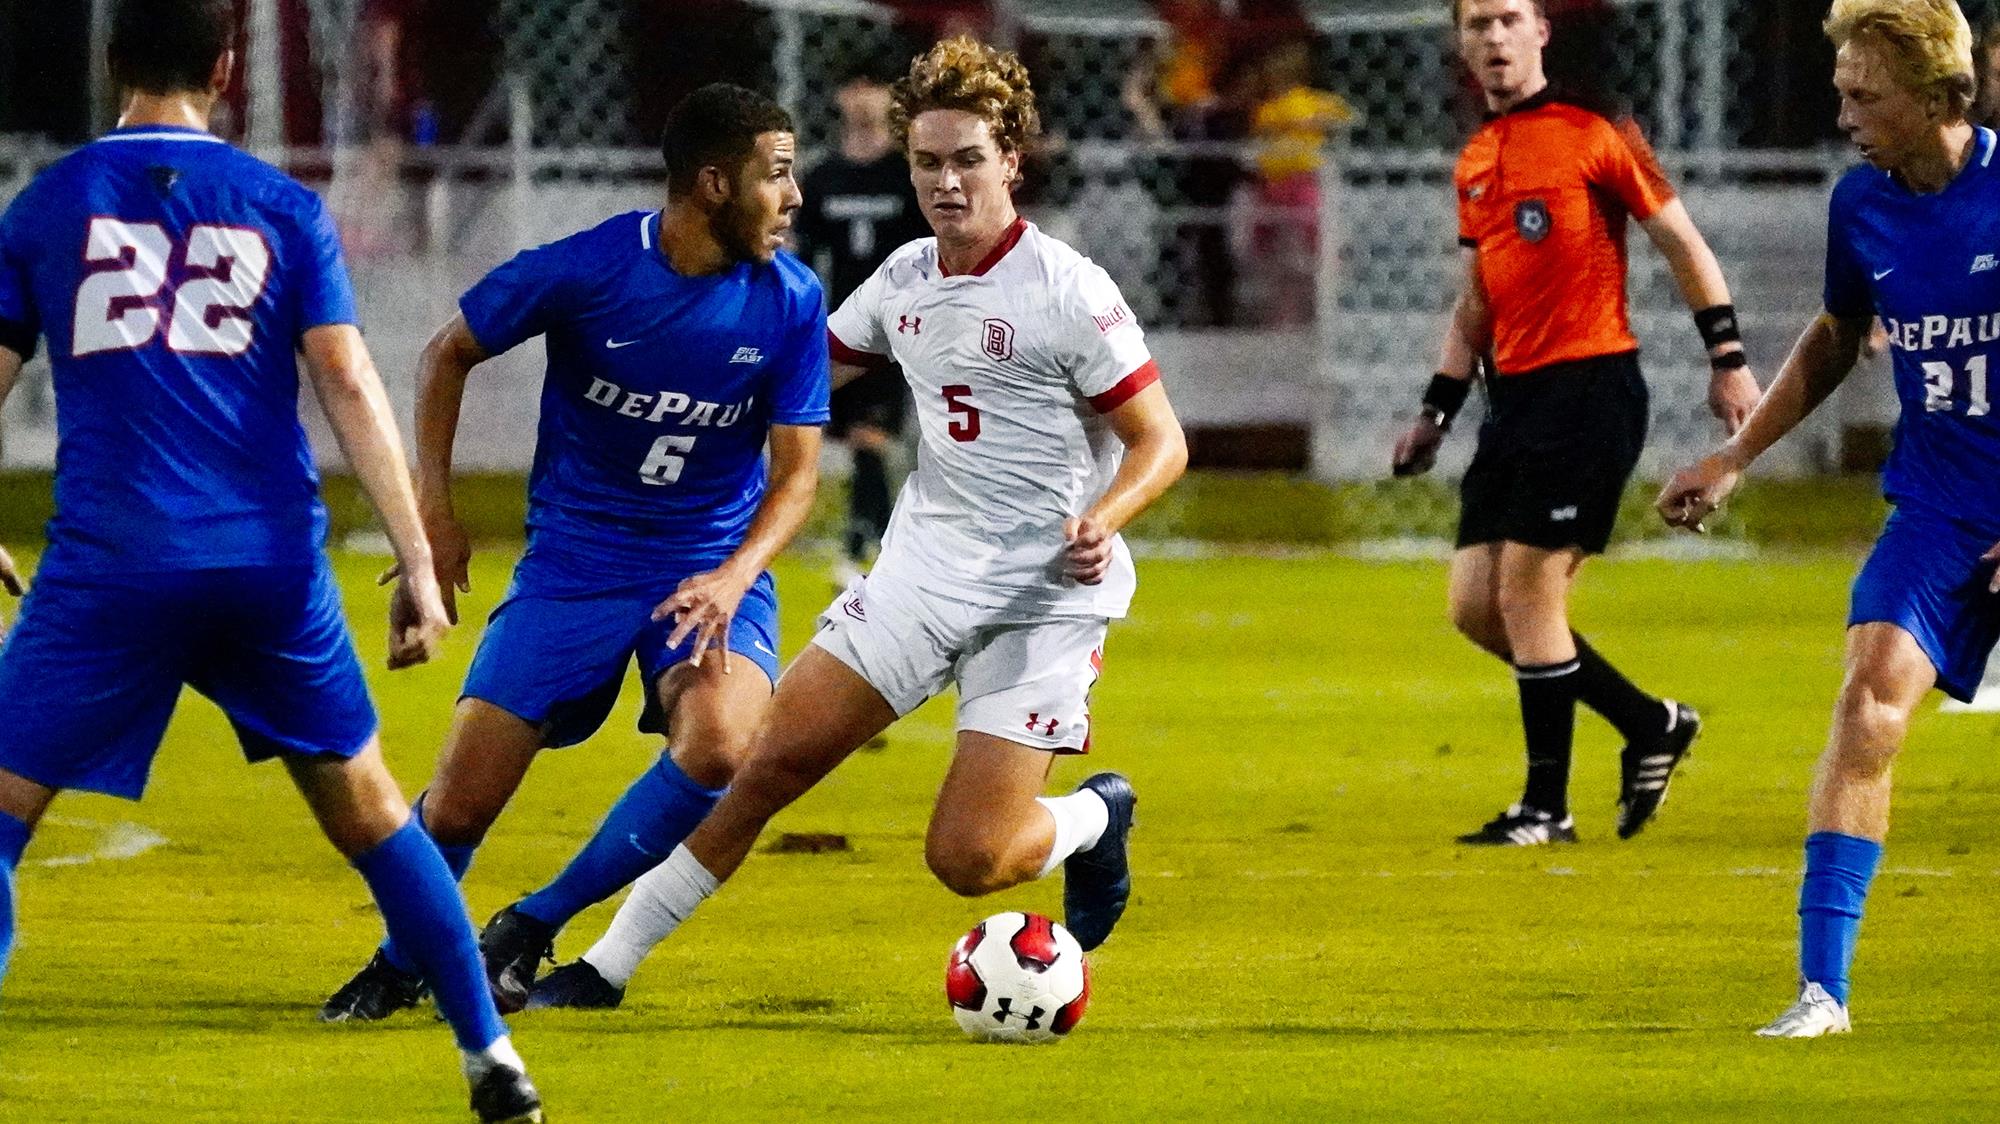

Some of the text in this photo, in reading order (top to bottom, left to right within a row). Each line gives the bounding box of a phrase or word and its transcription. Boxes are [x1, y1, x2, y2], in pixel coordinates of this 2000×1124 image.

[73, 216, 272, 359] 22
[731, 354, 764, 362] EAST
[583, 376, 754, 428] DEPAU
[1921, 354, 1991, 417] 21
[942, 385, 981, 442] 5
[638, 435, 697, 486] 6
